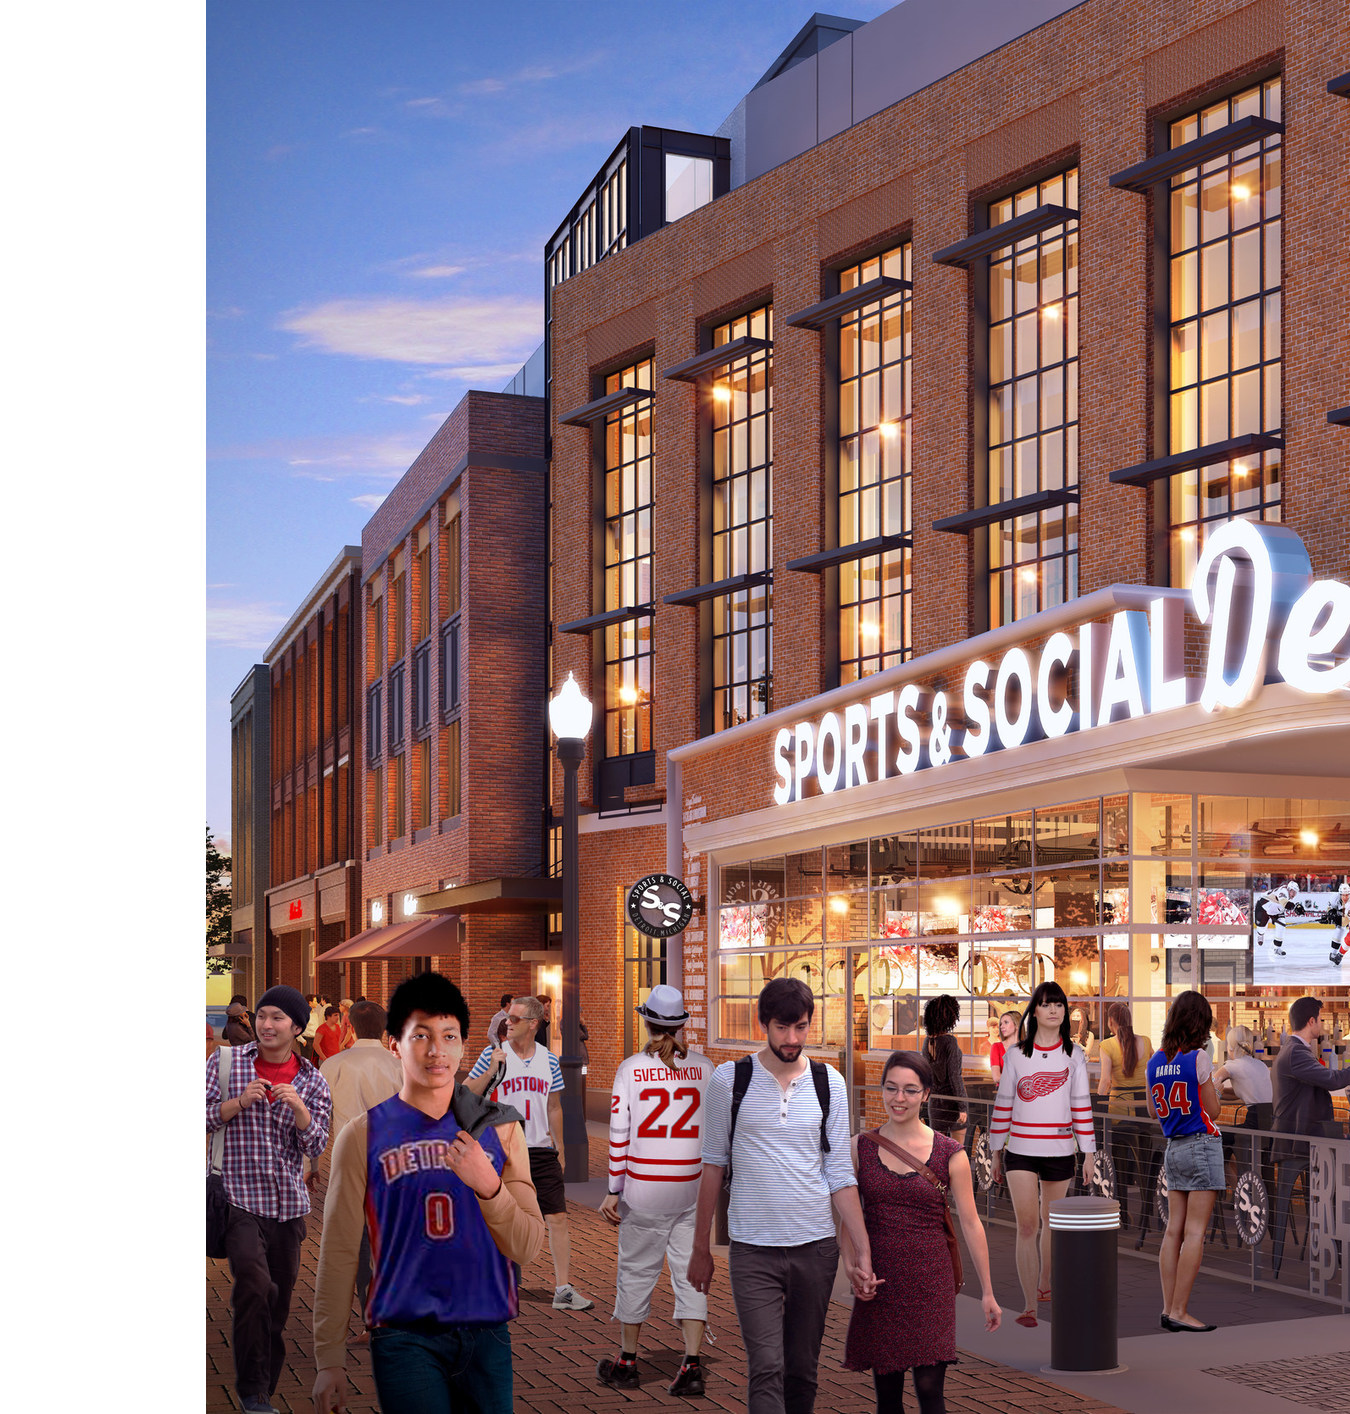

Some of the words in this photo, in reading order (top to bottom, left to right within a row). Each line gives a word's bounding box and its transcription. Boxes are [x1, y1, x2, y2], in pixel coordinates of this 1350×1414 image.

[774, 684, 921, 805] SPORTS
[929, 691, 951, 766] &
[963, 598, 1187, 757] SOCIAL
[632, 876, 656, 898] SPORTS
[668, 877, 690, 899] SOCIAL
[660, 913, 690, 937] MICHIGAN
[633, 1067, 702, 1082] SVECHNIKOV
[1156, 1064, 1181, 1078] HARRIS
[501, 1076, 549, 1096] PISTONS
[1151, 1081, 1192, 1118] 34
[637, 1087, 701, 1138] 22
[425, 1192, 454, 1239] 0
